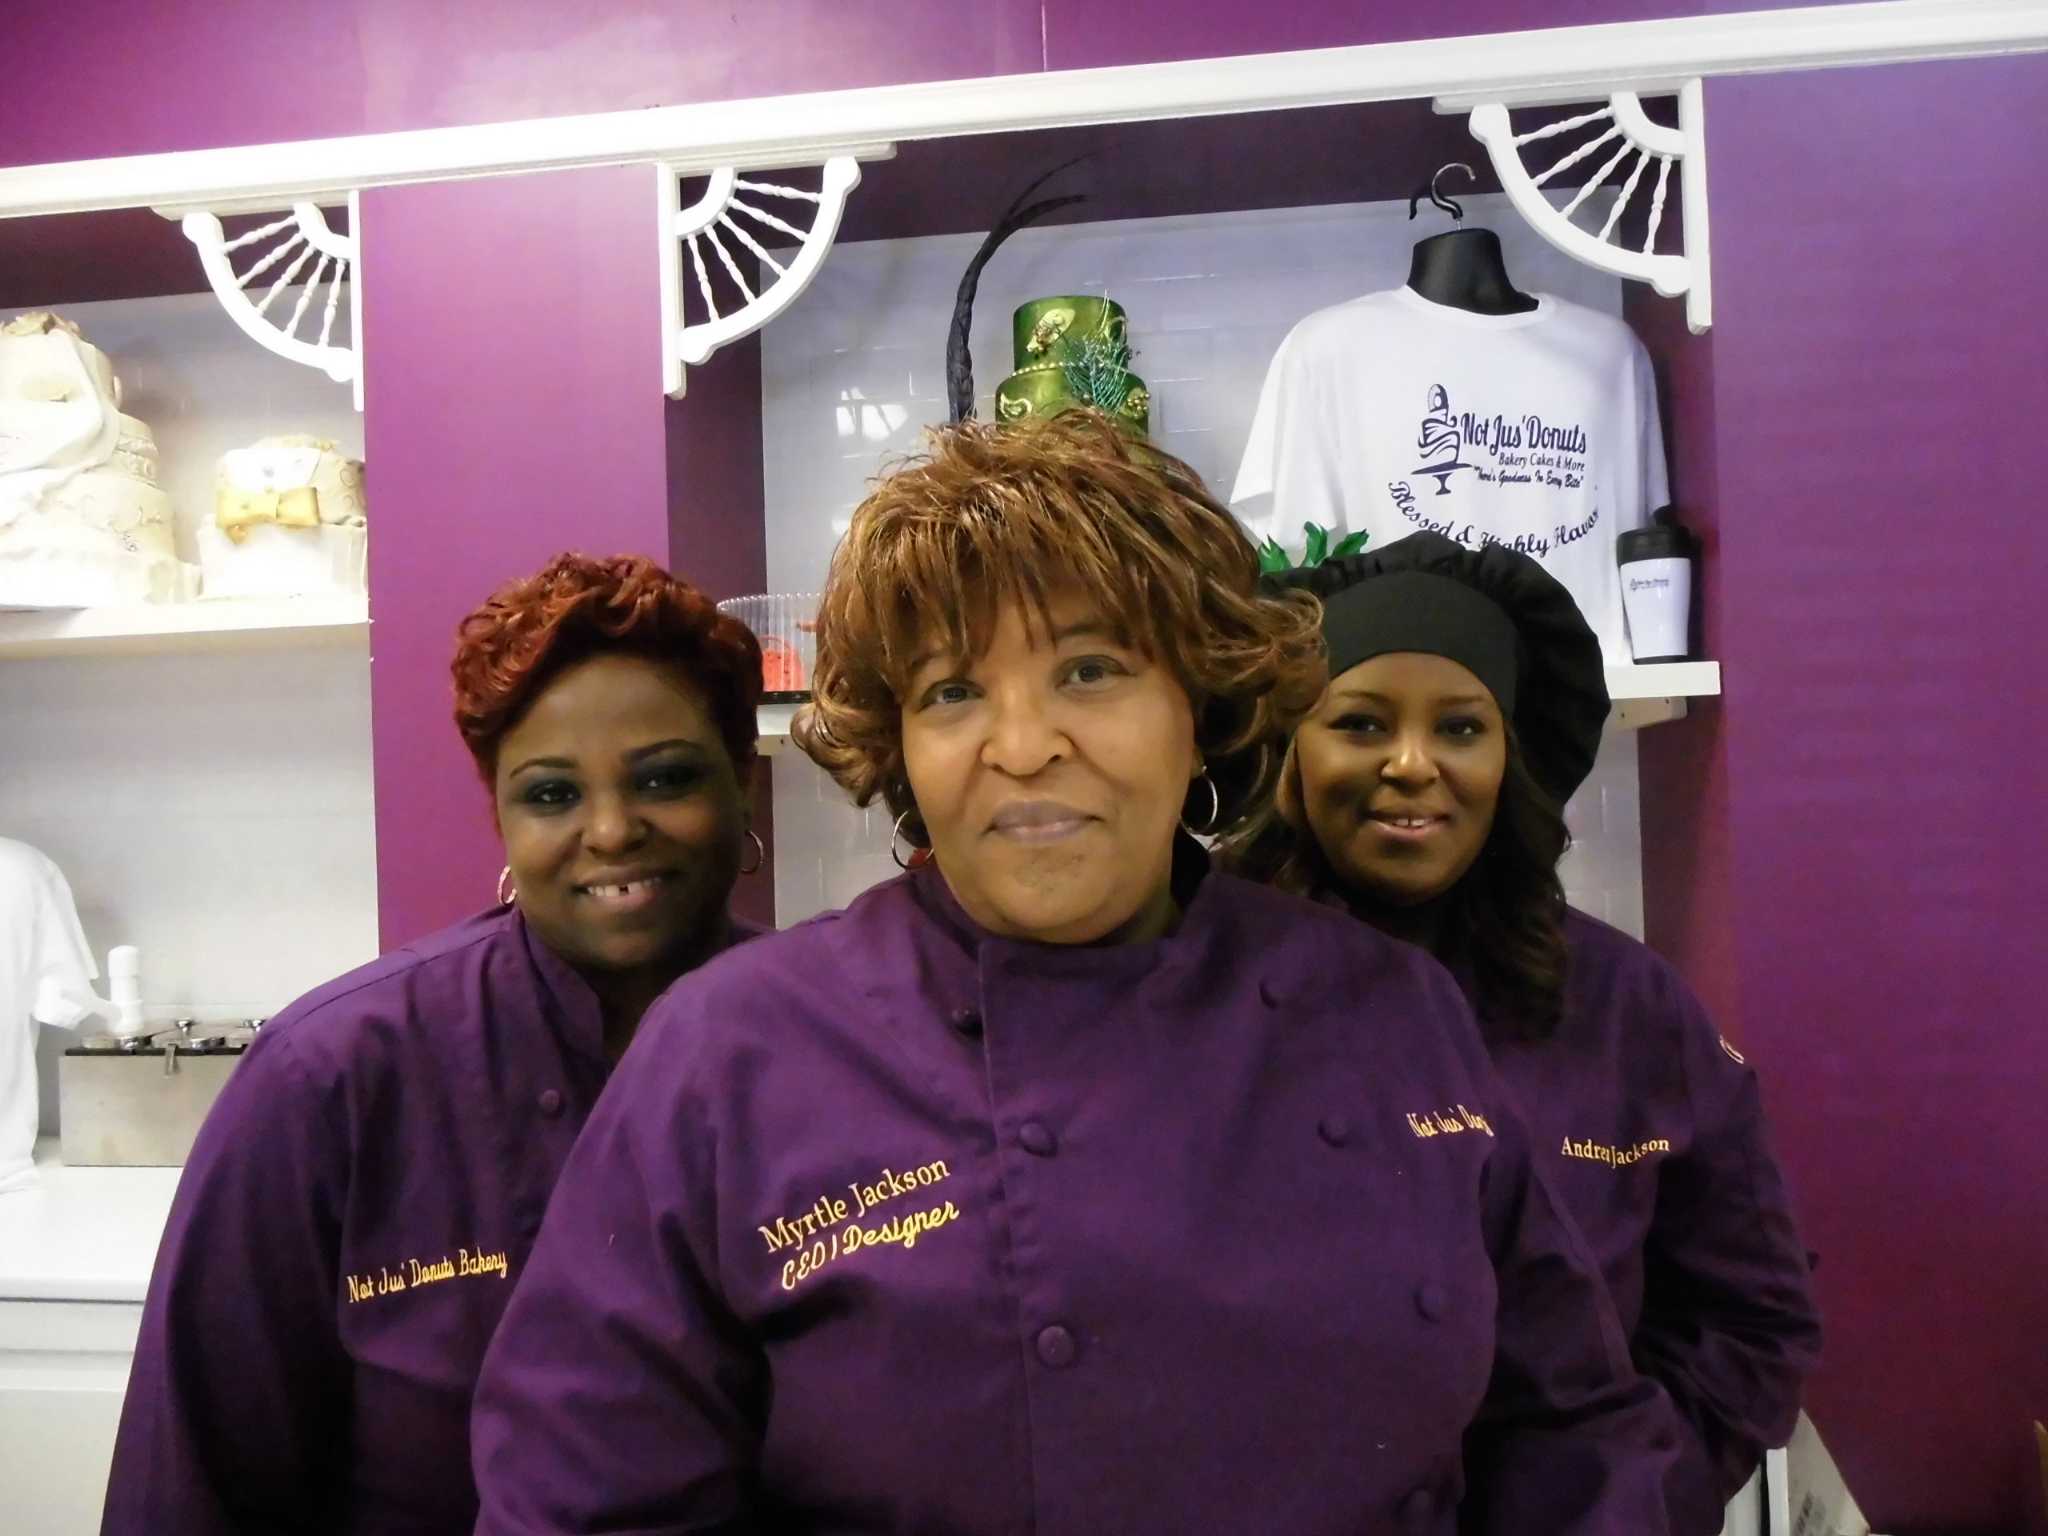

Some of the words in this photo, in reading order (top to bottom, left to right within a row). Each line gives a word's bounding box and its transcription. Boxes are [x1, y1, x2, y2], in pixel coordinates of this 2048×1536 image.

[1460, 412, 1489, 447] Not
[1526, 415, 1586, 454] Donuts
[1499, 452, 1527, 469] Bakery
[1530, 453, 1554, 467] Cakes
[1564, 457, 1585, 471] More
[1388, 480, 1455, 538] Blessed
[1406, 1113, 1438, 1137] Not
[758, 1195, 849, 1253] Myrtle
[847, 1159, 951, 1218] Jackson
[842, 1200, 960, 1255] Designer
[346, 1275, 374, 1303] Not
[409, 1255, 456, 1288] Donuts
[459, 1246, 508, 1279] Bakery
